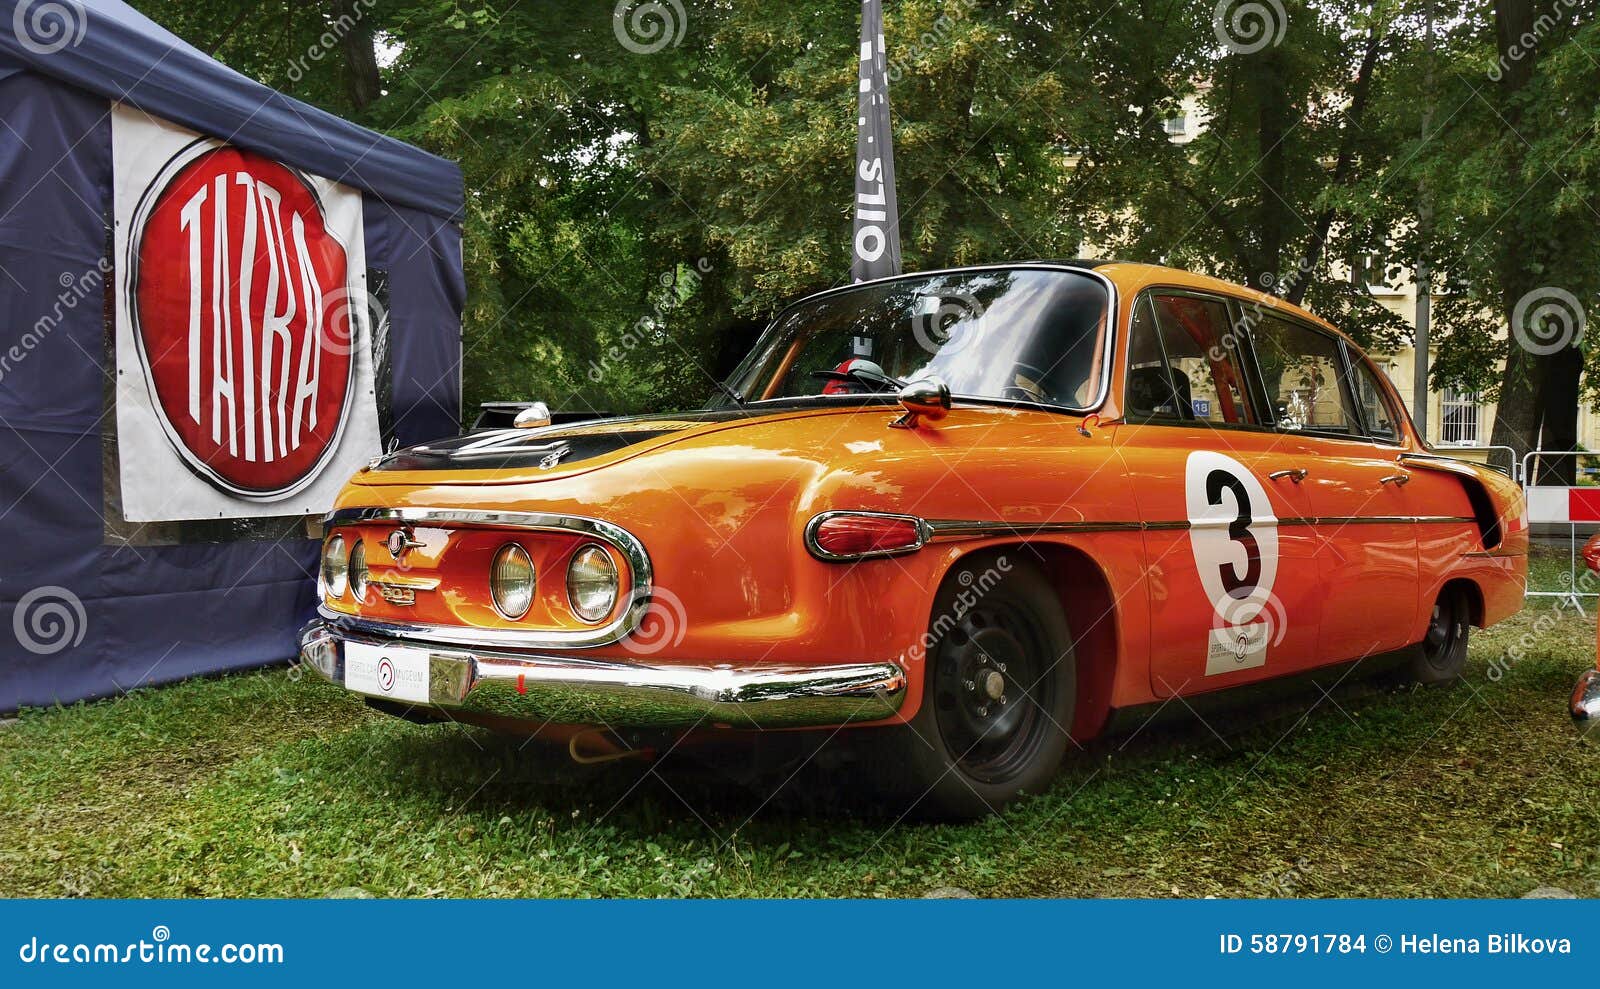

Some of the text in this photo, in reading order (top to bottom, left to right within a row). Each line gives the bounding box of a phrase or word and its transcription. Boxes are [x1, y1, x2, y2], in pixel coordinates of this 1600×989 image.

[855, 157, 887, 262] OILS
[181, 171, 322, 462] TATRA
[1195, 403, 1208, 413] 18
[1206, 469, 1262, 600] 3
